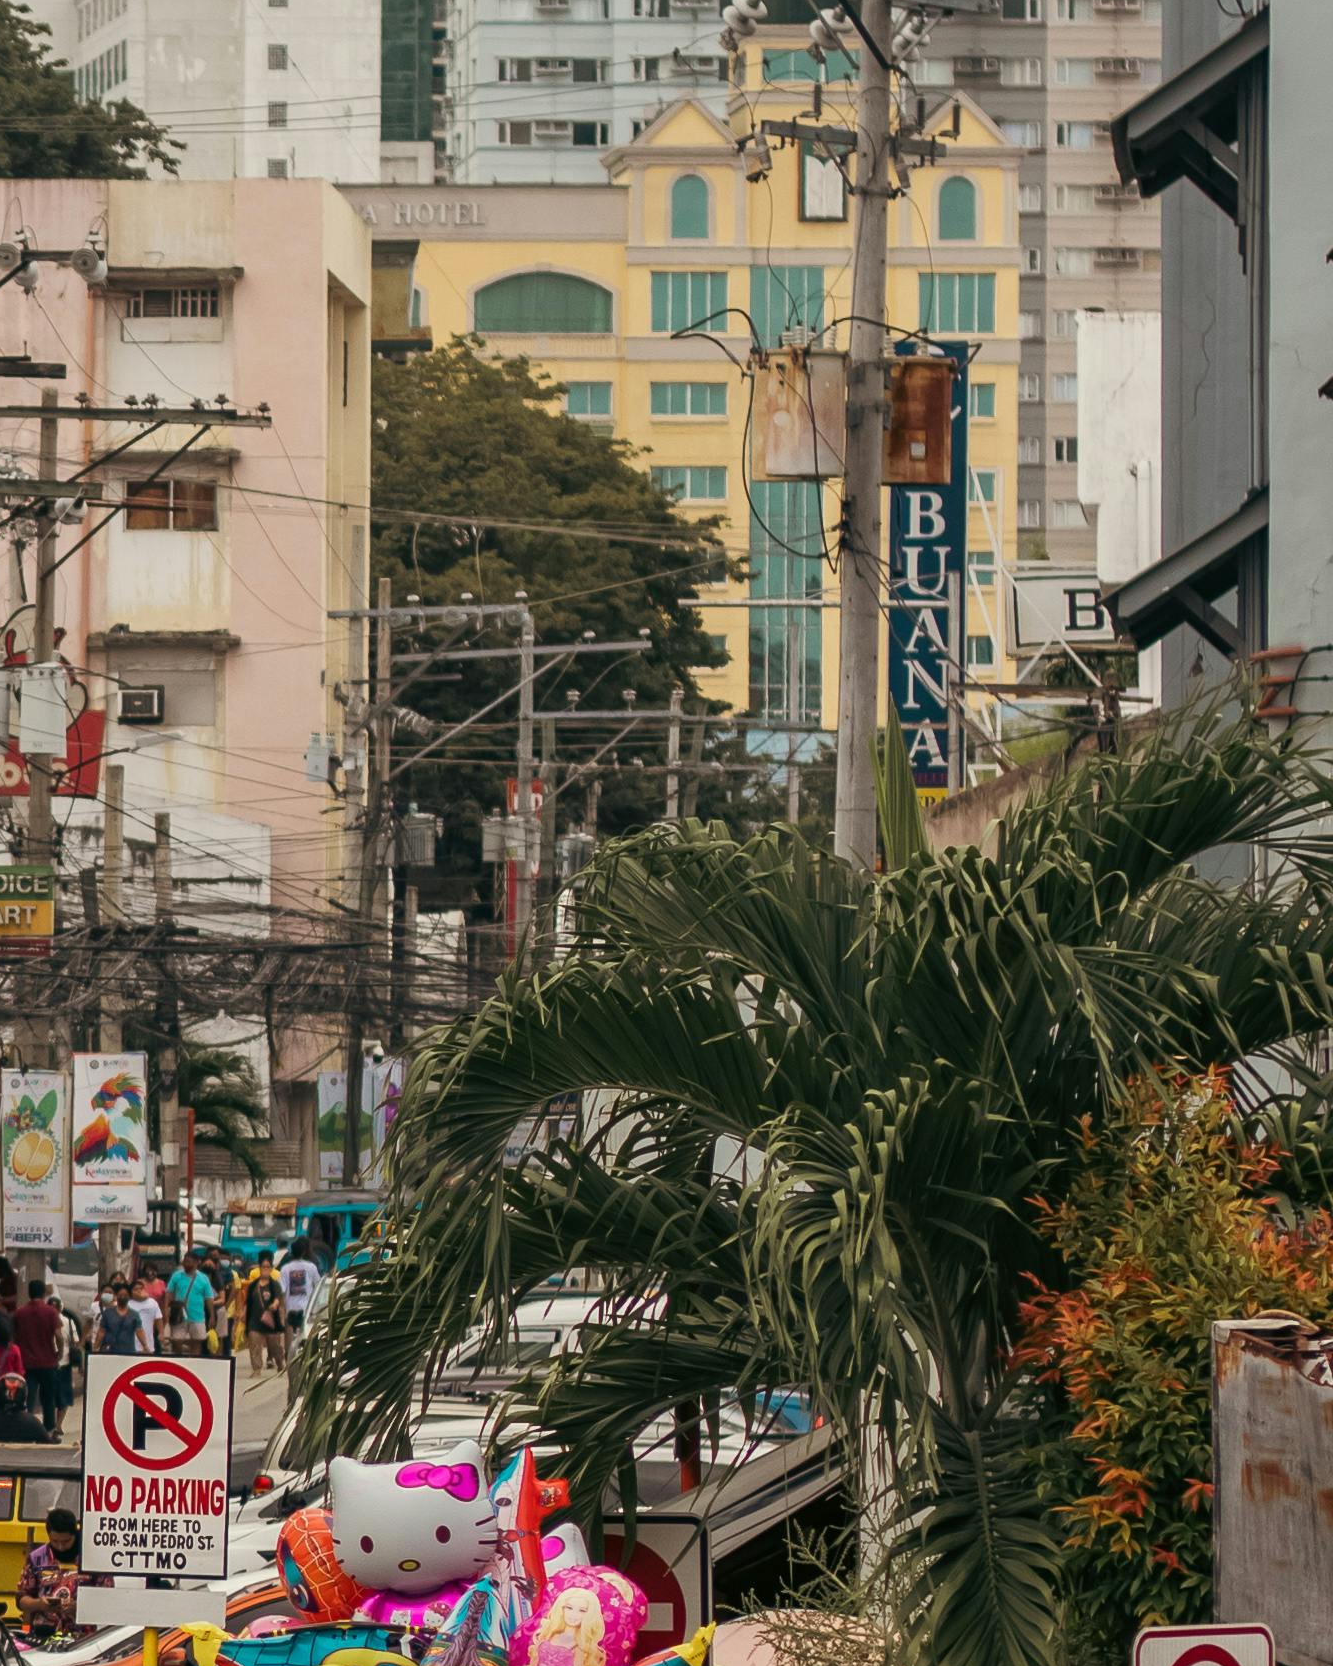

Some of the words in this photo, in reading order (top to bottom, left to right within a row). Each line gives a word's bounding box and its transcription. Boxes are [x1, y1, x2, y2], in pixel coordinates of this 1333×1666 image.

[394, 202, 485, 226] HOTEL
[902, 491, 951, 768] BUANA
[85, 1475, 122, 1512] NO
[130, 1477, 225, 1516] PARKING
[99, 1517, 137, 1532] FROM
[141, 1519, 178, 1533] HERE
[183, 1520, 201, 1533] TO
[93, 1532, 120, 1546] COR.
[123, 1533, 147, 1547] SAN
[151, 1534, 193, 1549] PEDRO
[197, 1535, 214, 1550] ST.
[111, 1551, 187, 1569] CTTMO
